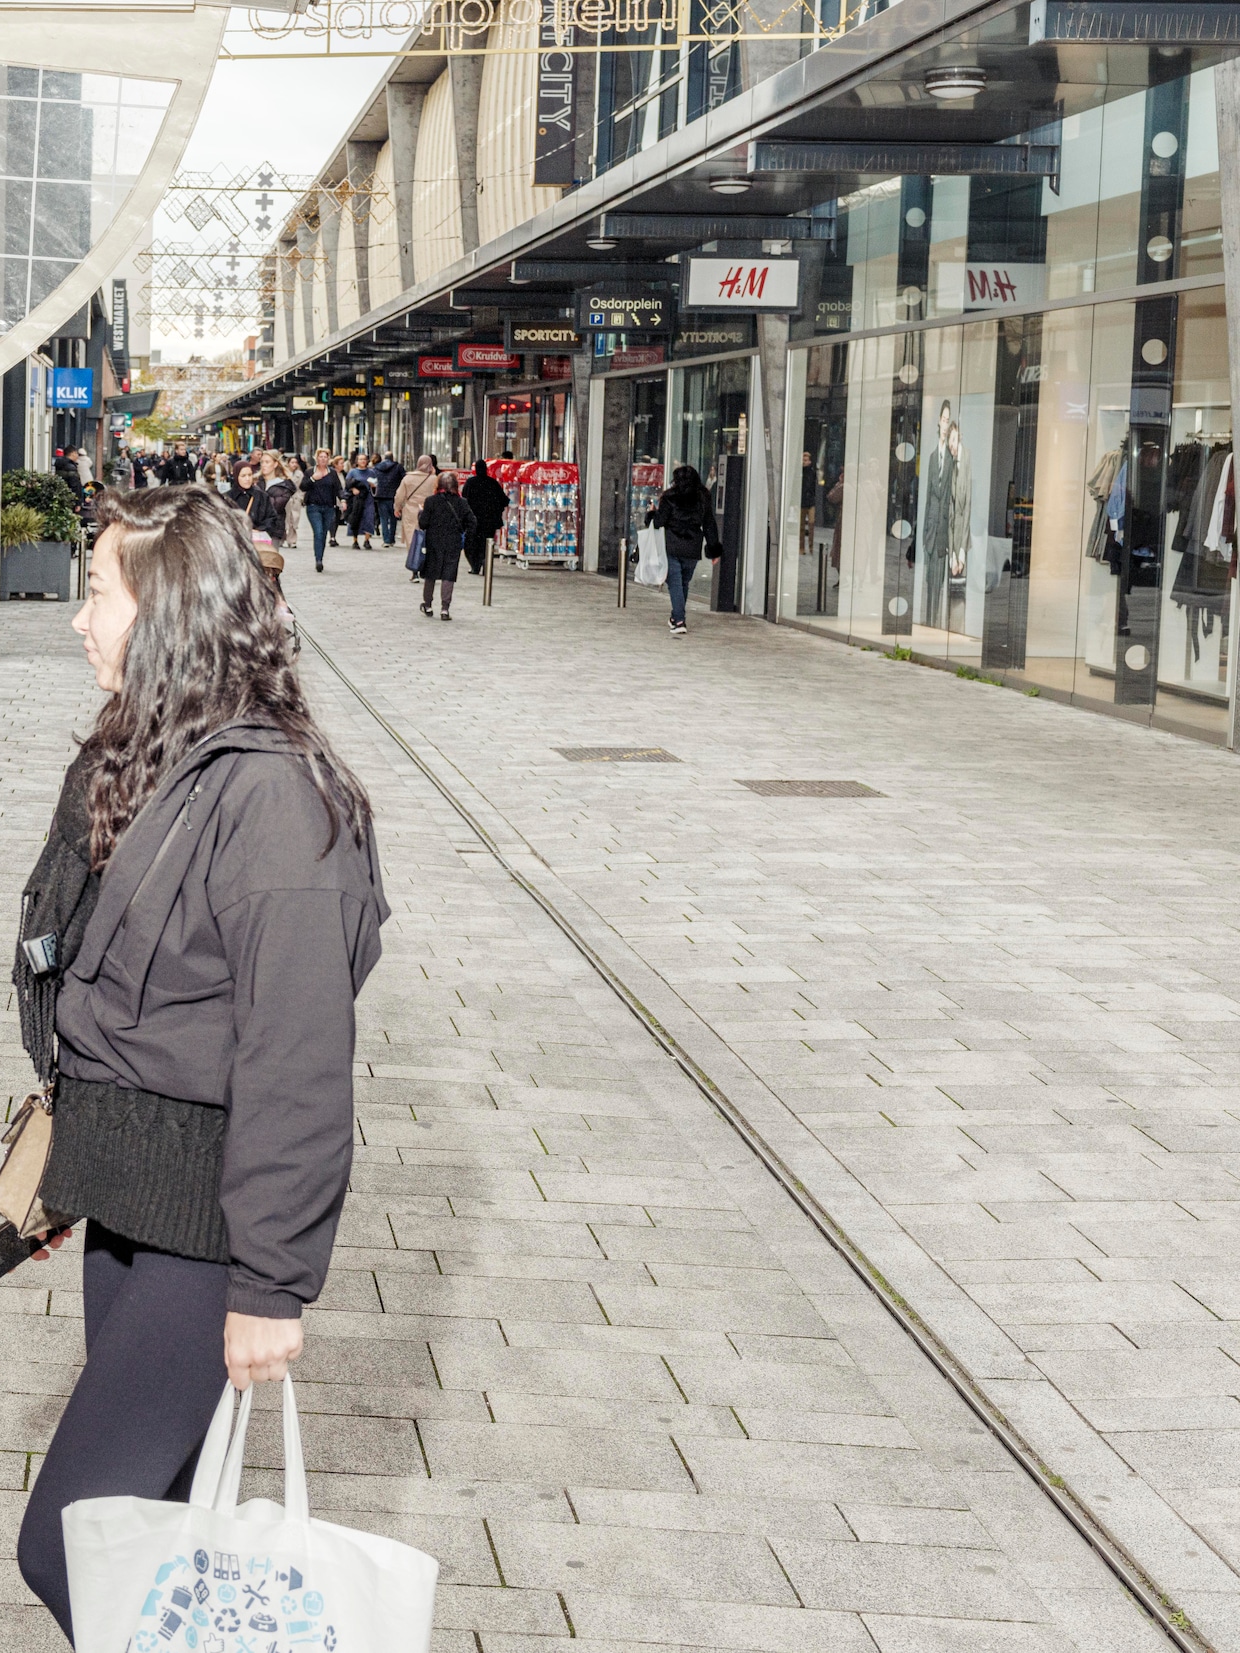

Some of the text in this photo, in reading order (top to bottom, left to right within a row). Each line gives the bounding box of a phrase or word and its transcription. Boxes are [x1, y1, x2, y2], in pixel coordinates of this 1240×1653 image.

[538, 0, 575, 132] RTCITY
[717, 266, 769, 299] H&M
[589, 297, 662, 312] Osdorpplein
[112, 286, 126, 351] WESTMARKET
[475, 351, 512, 361] Kruidvat
[56, 386, 88, 399] KLIK
[333, 387, 367, 397] xenos
